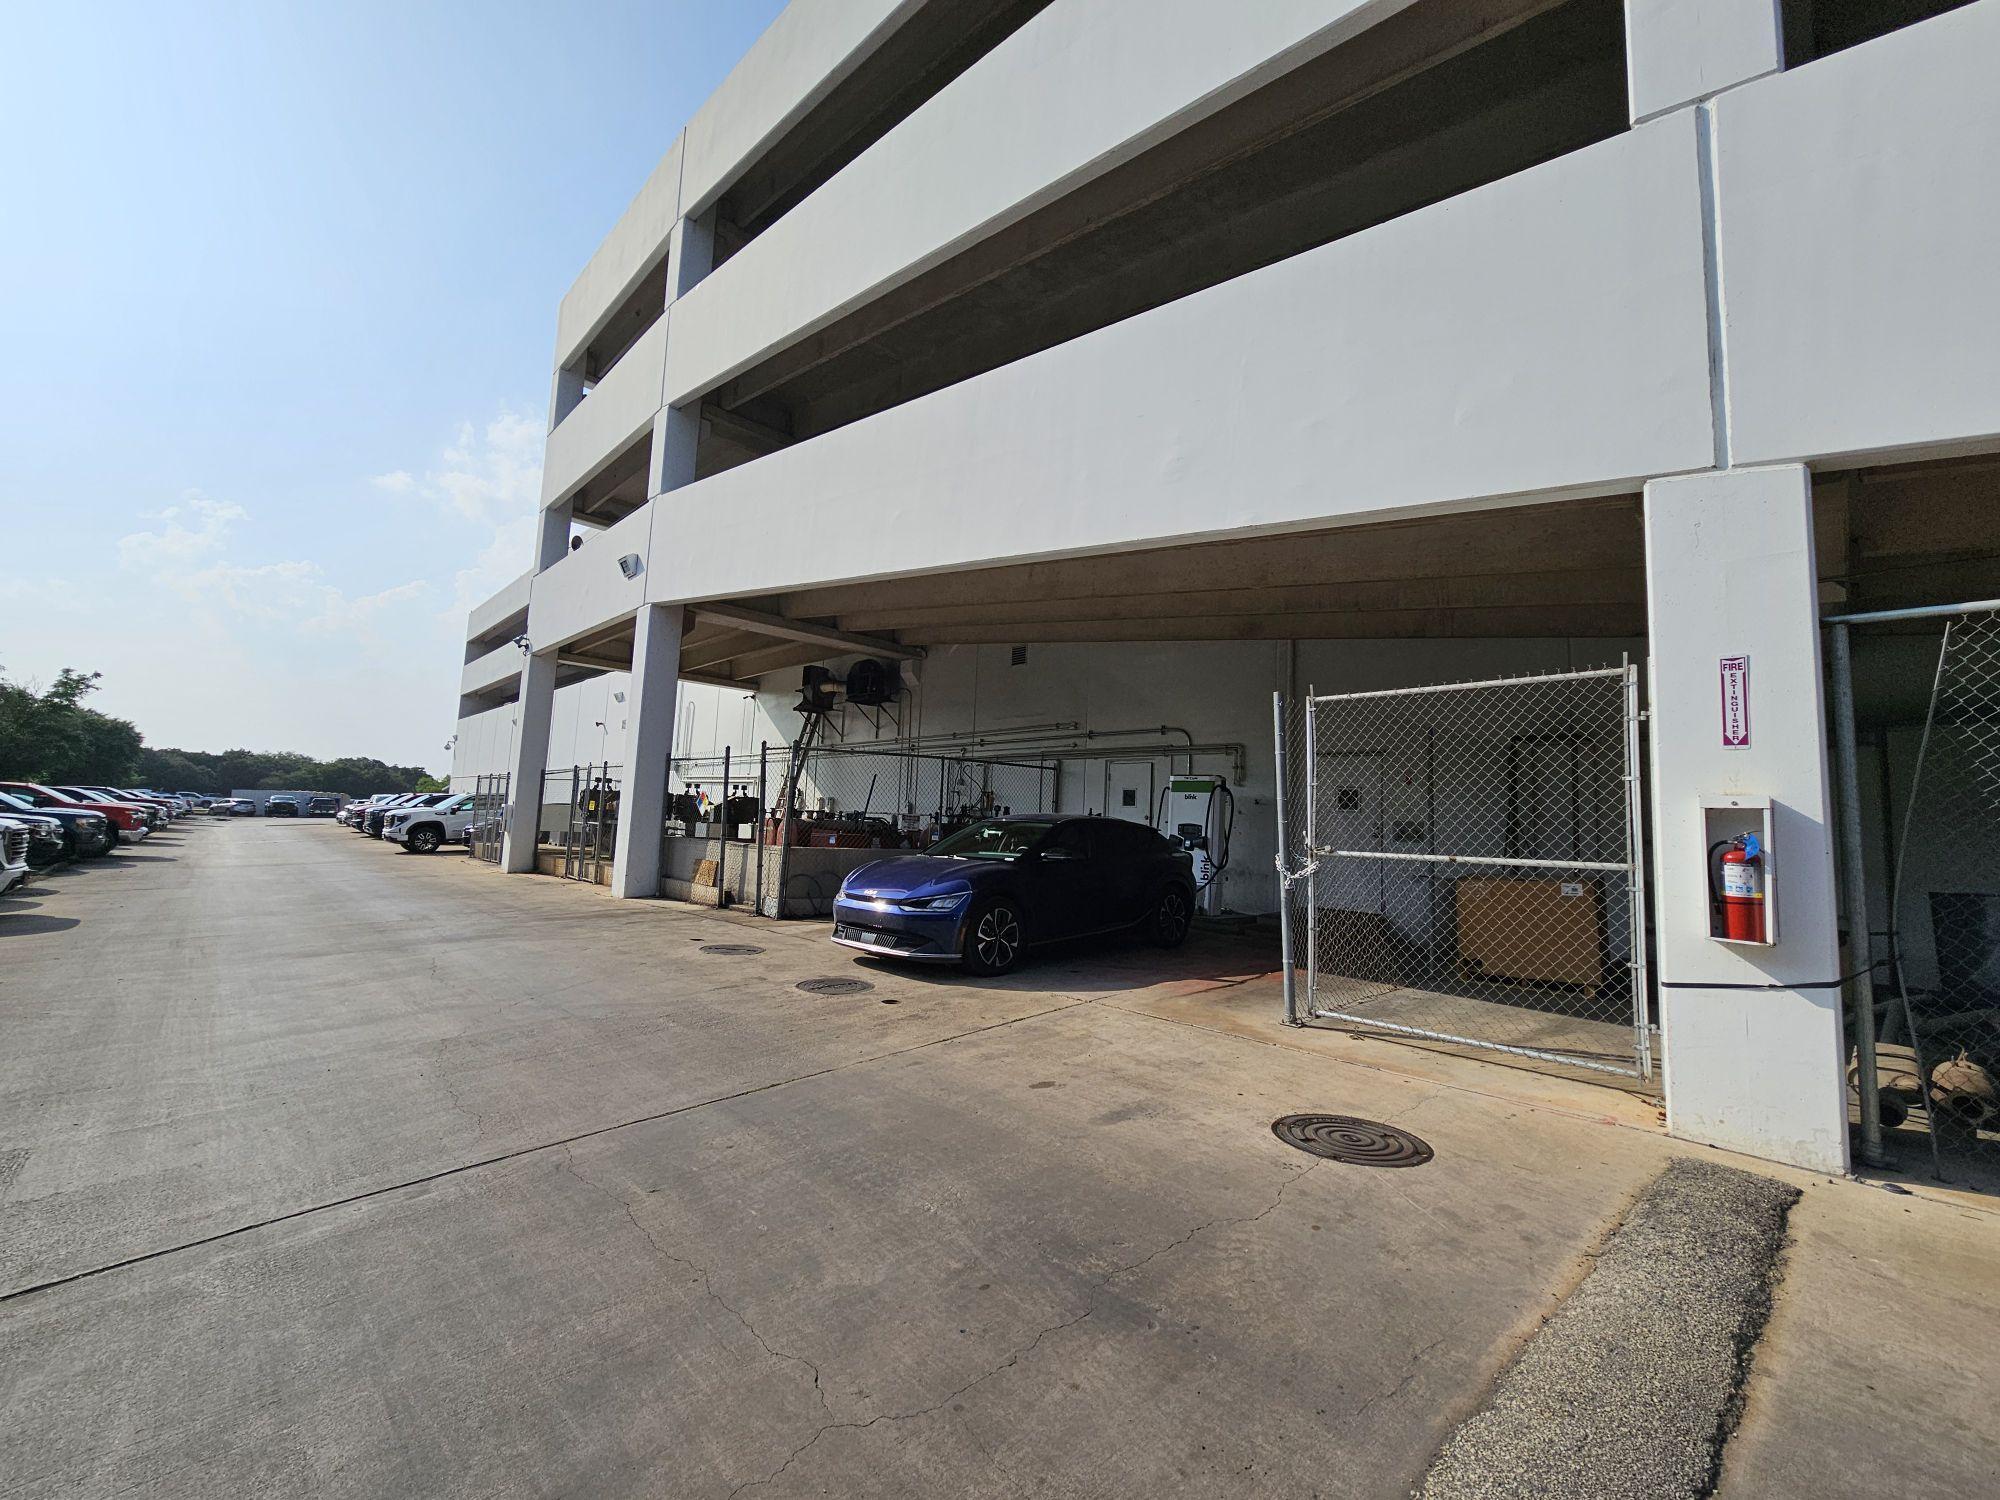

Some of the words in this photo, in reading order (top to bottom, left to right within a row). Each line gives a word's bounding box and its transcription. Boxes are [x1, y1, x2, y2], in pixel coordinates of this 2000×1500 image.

[1722, 662, 1744, 672] FIRE
[1730, 672, 1740, 741] EXTINGUISHER
[1200, 855, 1211, 881] blink
